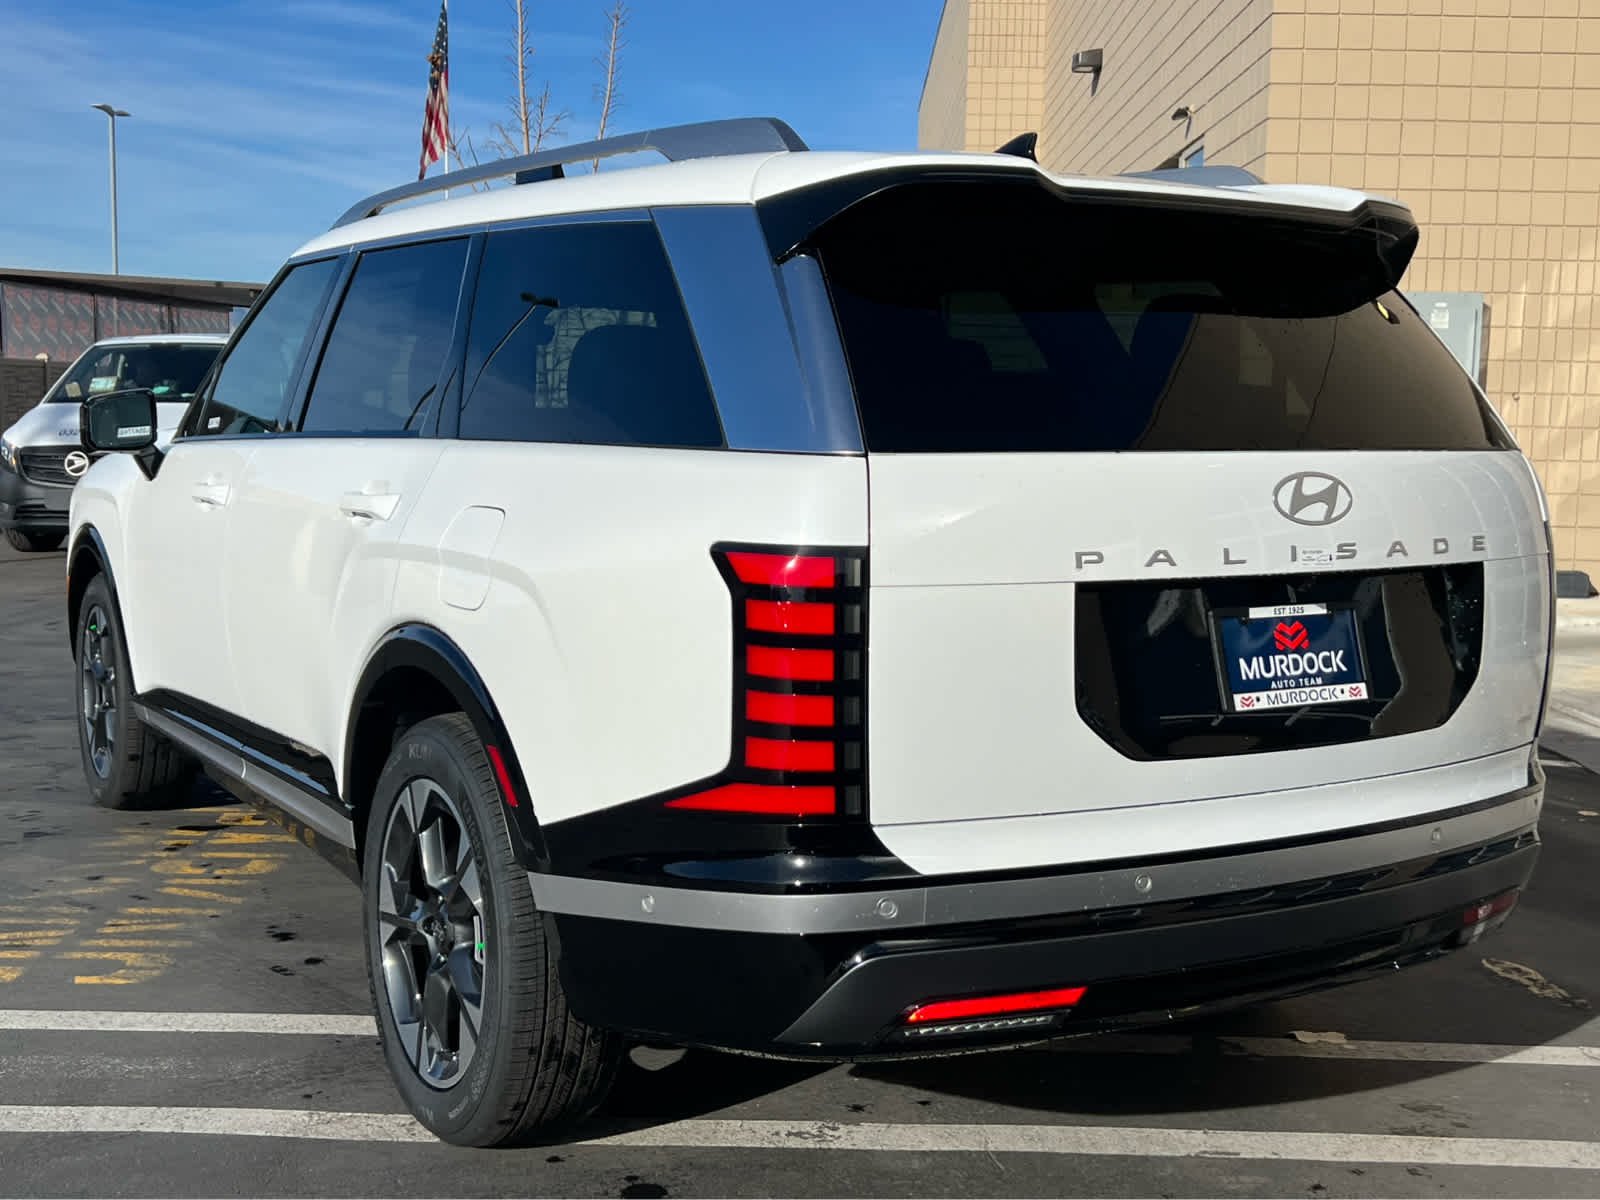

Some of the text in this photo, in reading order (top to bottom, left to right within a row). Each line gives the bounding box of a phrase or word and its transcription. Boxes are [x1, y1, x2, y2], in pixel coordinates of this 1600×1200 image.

[1075, 536, 1486, 569] PALISADE
[1273, 607, 1286, 616] EST
[1238, 650, 1347, 681] MURDOCK
[1271, 677, 1323, 689] AUTO TEAM
[1266, 687, 1338, 706] MURDOCK
